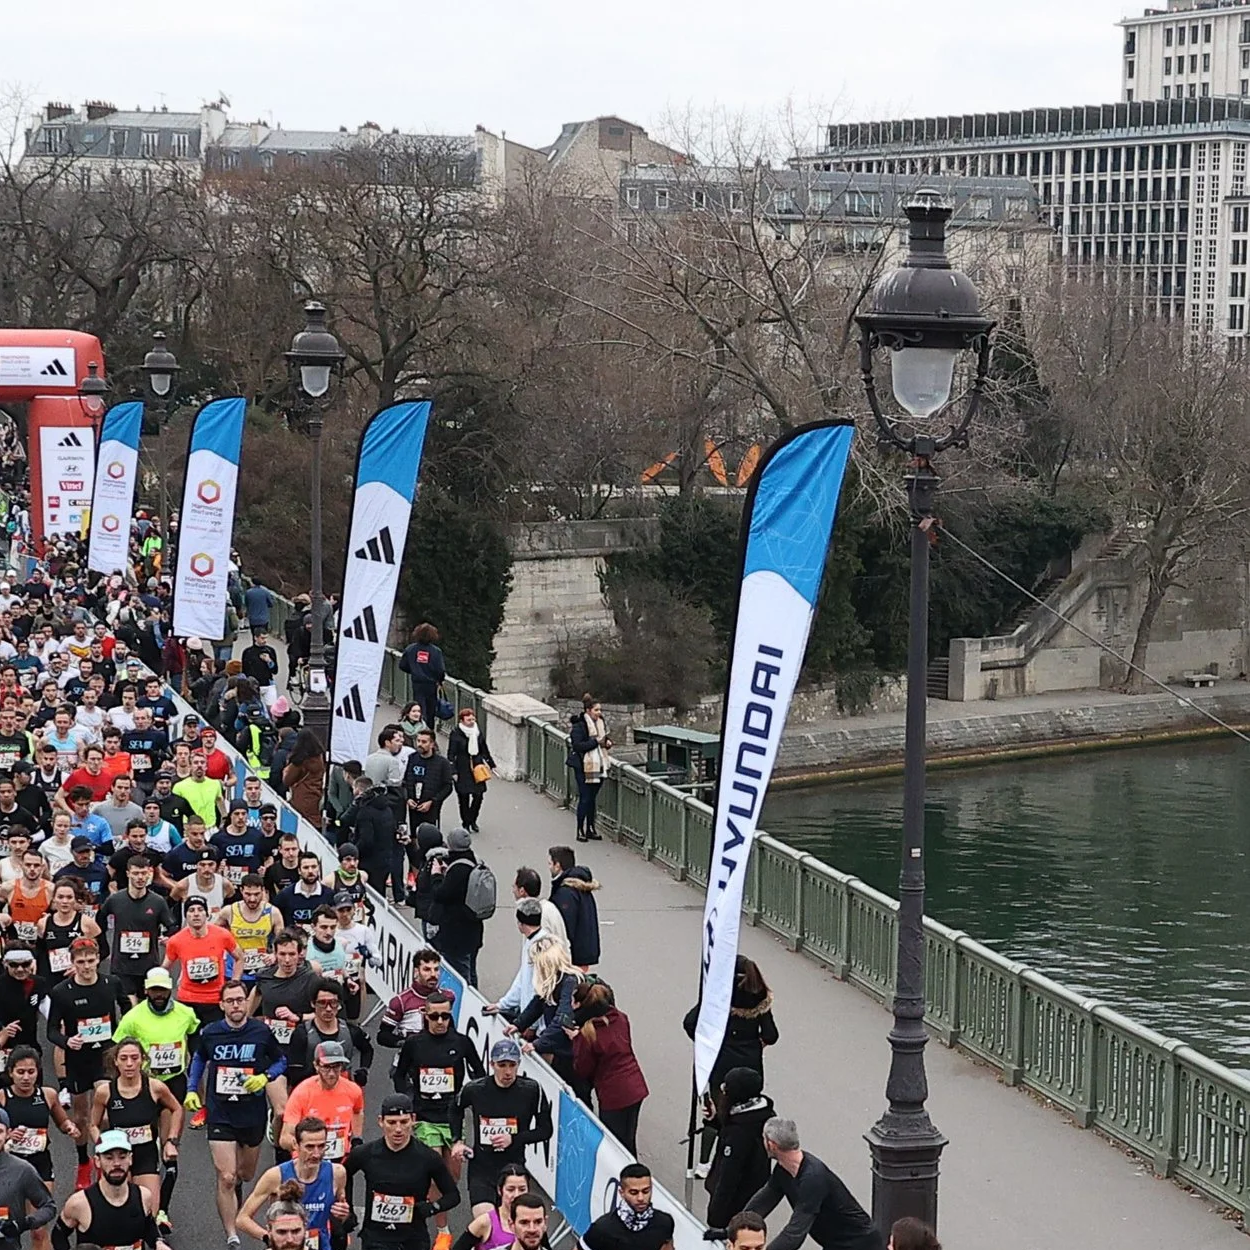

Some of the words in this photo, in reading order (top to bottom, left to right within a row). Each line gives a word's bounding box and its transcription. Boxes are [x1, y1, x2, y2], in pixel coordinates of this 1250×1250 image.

[88, 1025, 102, 1036] 92
[154, 1051, 175, 1061] 446
[421, 1075, 449, 1086] 4294
[376, 1203, 407, 1216] 1669
